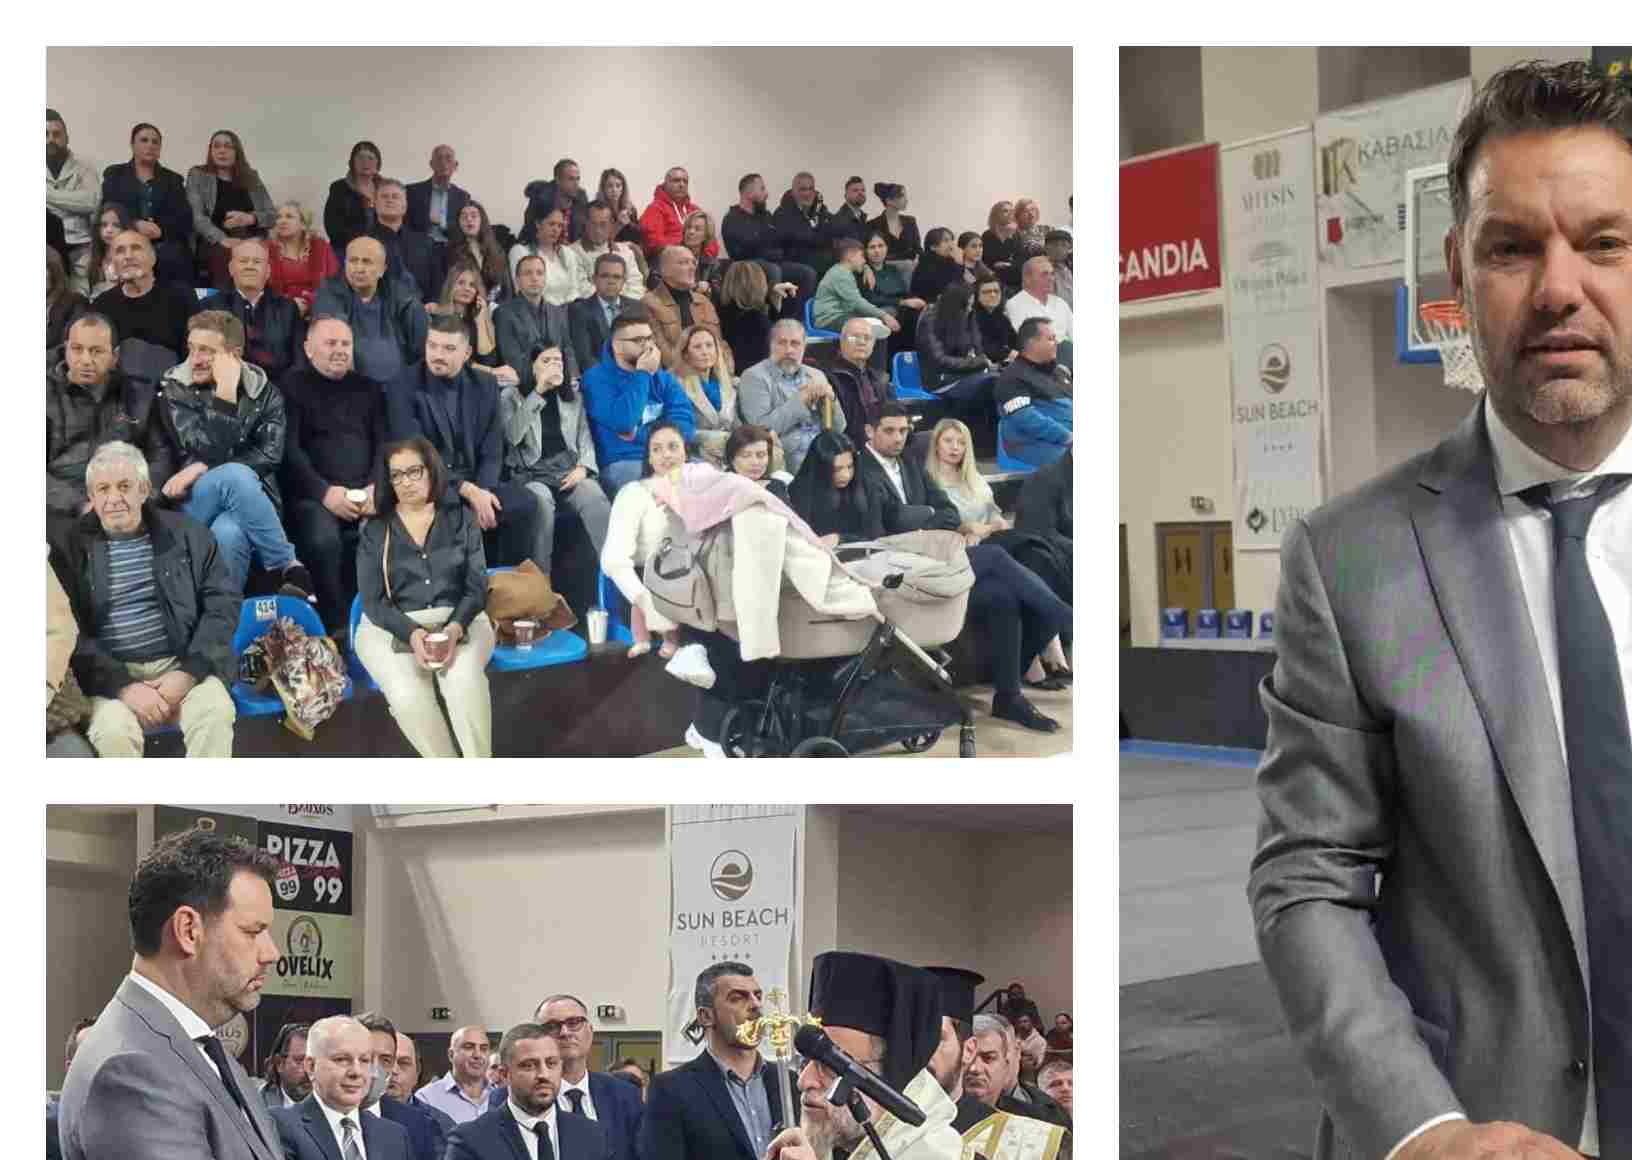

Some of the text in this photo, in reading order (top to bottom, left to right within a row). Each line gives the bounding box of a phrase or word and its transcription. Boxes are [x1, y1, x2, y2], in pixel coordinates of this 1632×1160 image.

[1237, 398, 1319, 424] SUN BEACH
[266, 834, 341, 869] PIZZA
[279, 879, 297, 897] 99
[313, 875, 344, 904] 99
[677, 906, 789, 931] SUN BEACH
[275, 954, 335, 981] OVELIX
